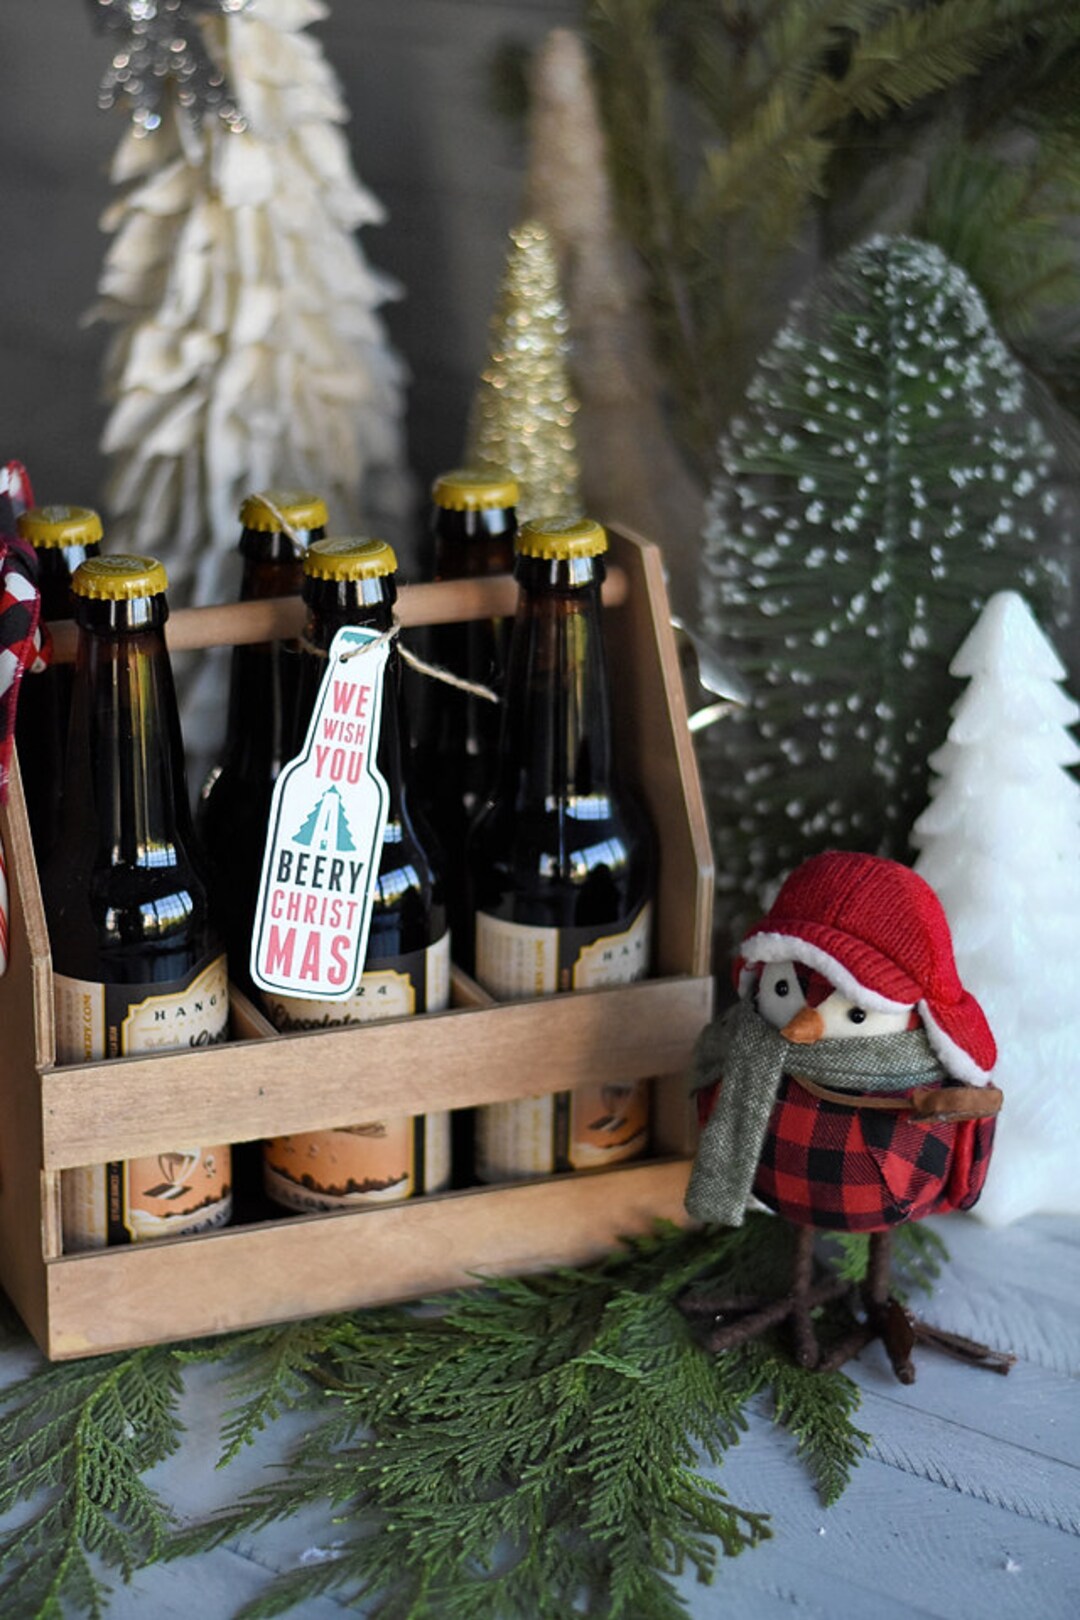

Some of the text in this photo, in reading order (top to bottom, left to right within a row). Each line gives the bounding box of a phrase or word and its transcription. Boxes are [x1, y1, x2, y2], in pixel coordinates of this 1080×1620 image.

[332, 679, 371, 719] WE
[322, 717, 366, 746] WISH
[315, 744, 364, 786] YOU
[276, 849, 365, 894] BEERY
[270, 888, 359, 931] CHRIST
[264, 924, 352, 987] MAS
